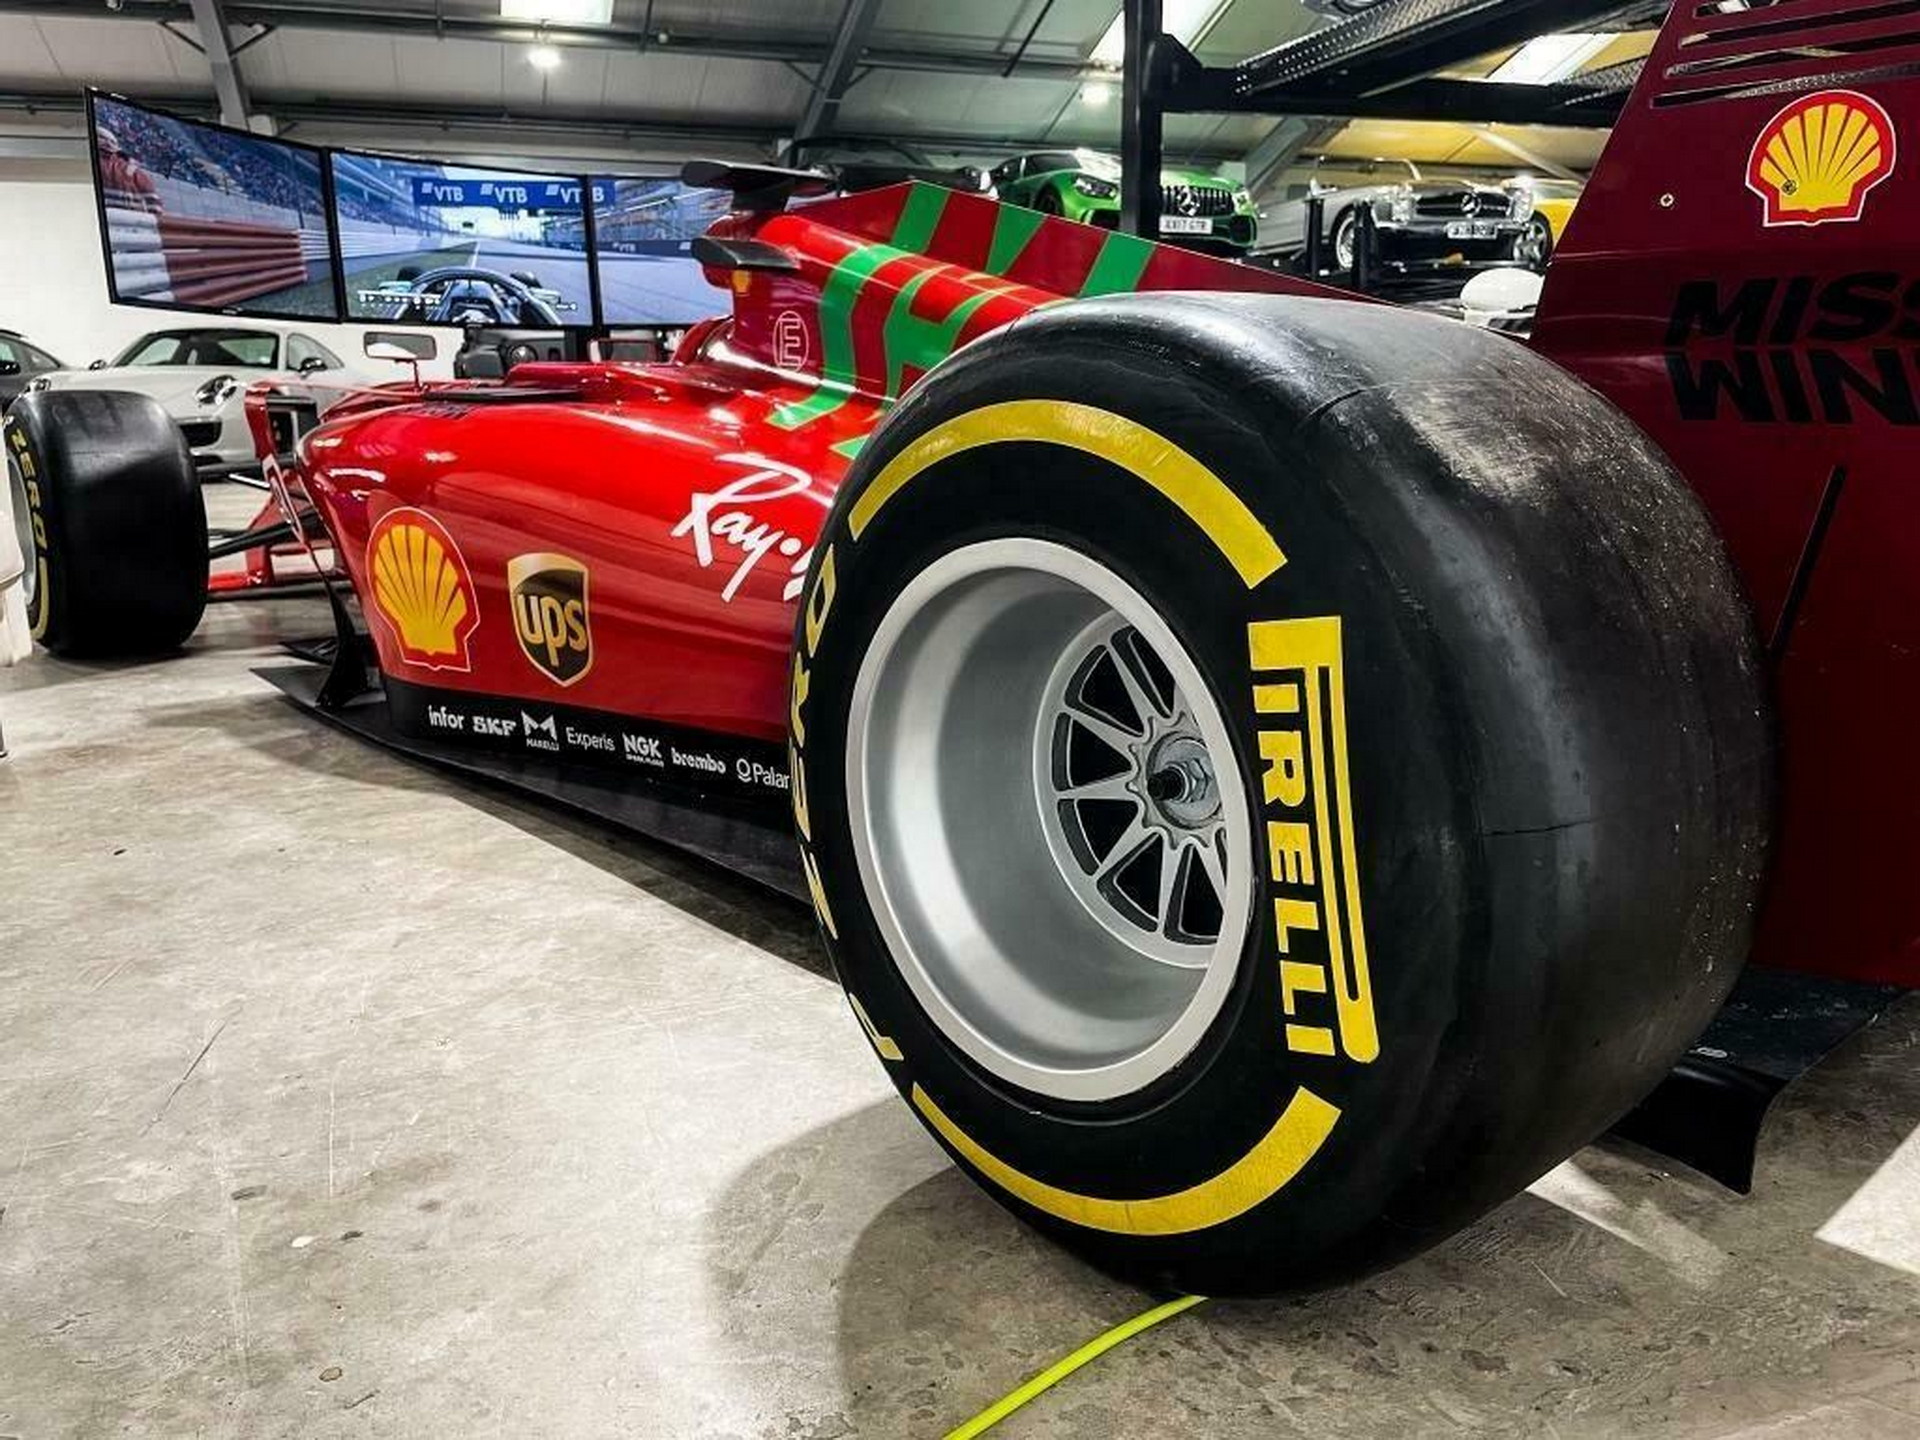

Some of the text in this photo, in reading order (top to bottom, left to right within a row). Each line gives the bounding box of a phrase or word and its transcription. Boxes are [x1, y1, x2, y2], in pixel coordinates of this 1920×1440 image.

[433, 186, 464, 201] VTB
[493, 186, 528, 203] VTB
[1663, 348, 1920, 428] WIN
[428, 704, 465, 731] infor
[472, 715, 518, 737] SKF
[565, 726, 616, 752] Experis
[622, 731, 663, 758] NGK
[671, 747, 727, 774] brembo
[1247, 615, 1381, 1064] PIRELLI
